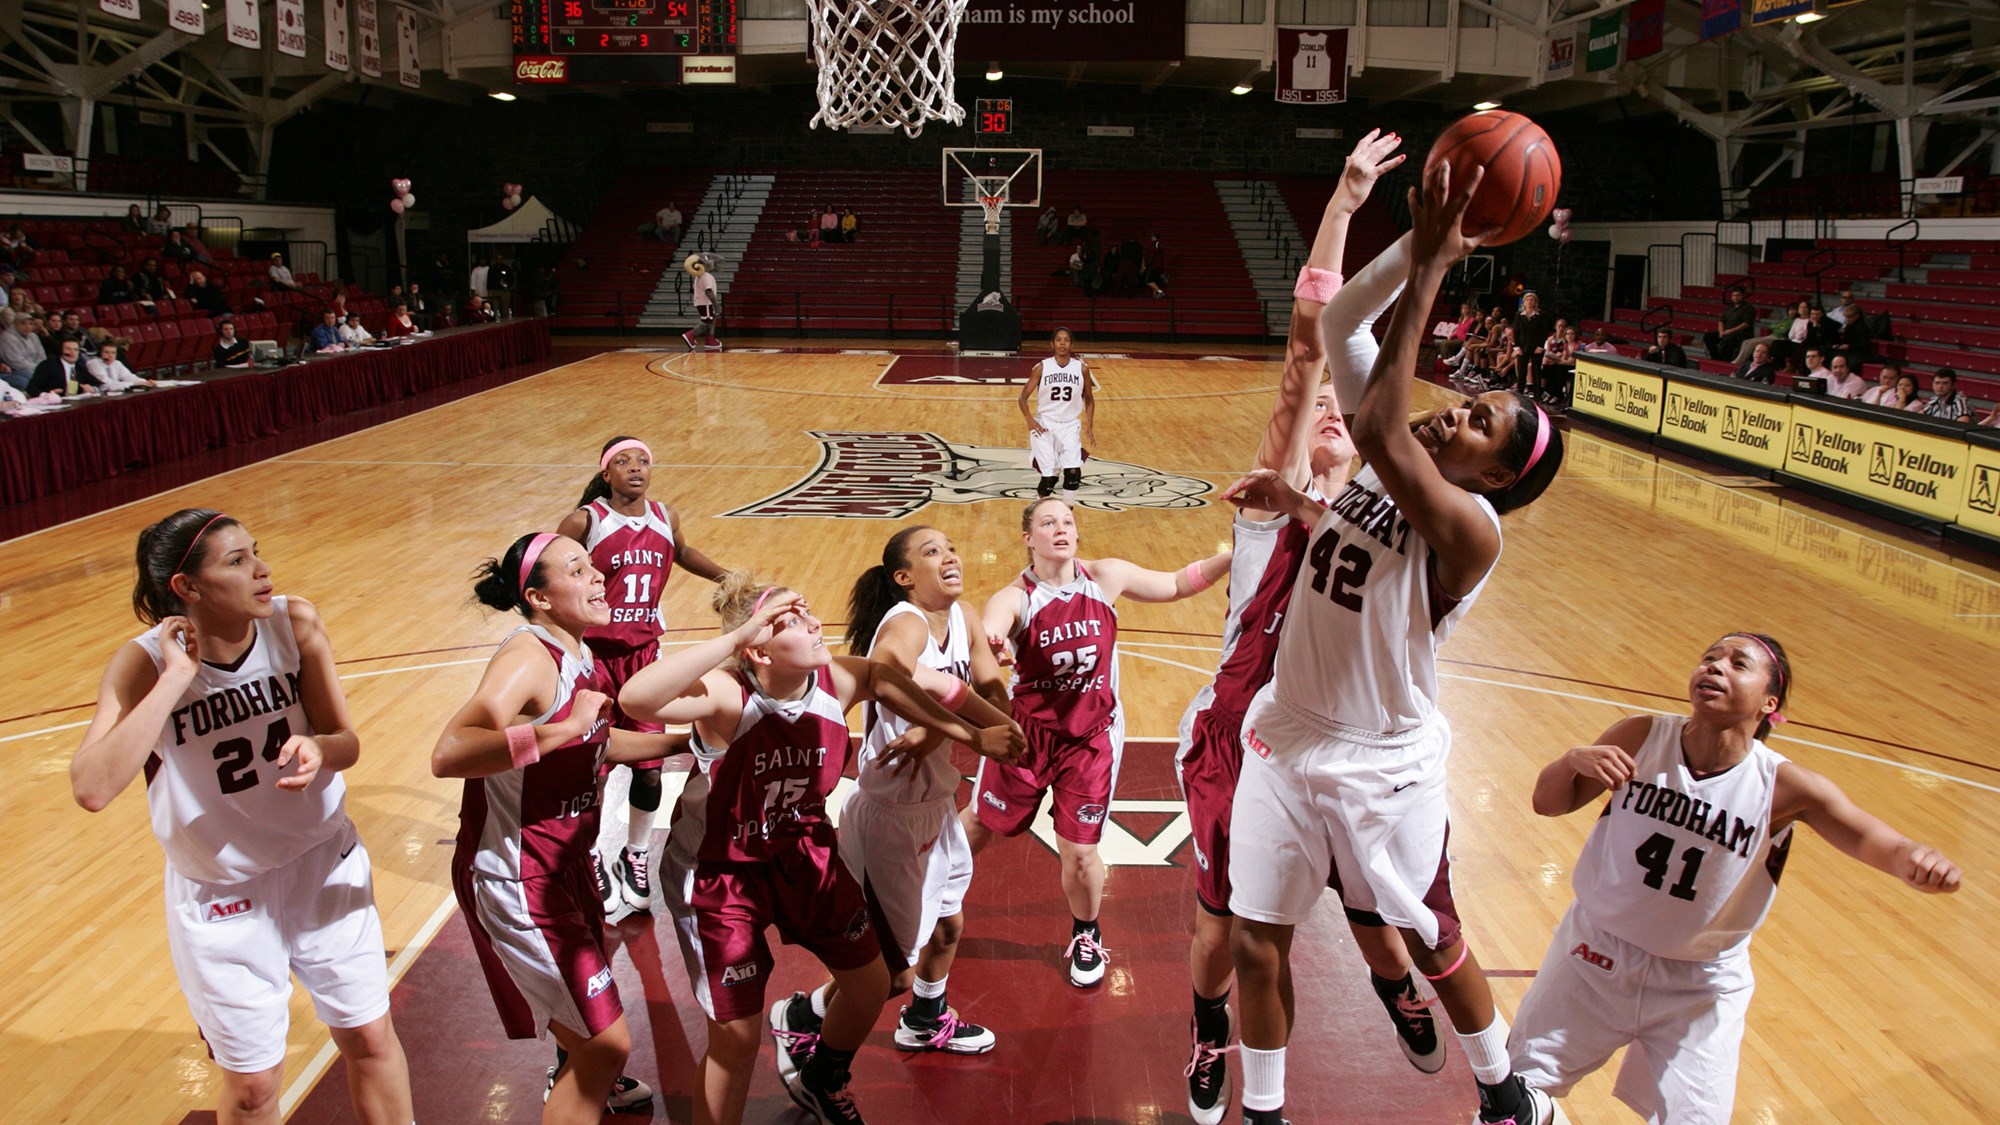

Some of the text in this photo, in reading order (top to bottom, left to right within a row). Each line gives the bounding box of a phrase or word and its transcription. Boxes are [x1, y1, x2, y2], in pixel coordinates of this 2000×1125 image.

[563, 1, 583, 17] 36
[667, 1, 687, 17] 54
[1009, 3, 1026, 24] is
[1031, 9, 1064, 30] my
[1068, 2, 1135, 24] school
[629, 14, 638, 26] 2
[567, 35, 575, 46] 4
[600, 33, 609, 47] 2
[640, 33, 649, 47] 3
[680, 35, 689, 47] 2
[516, 60, 566, 79] Coca-Cola
[1306, 55, 1316, 68] 11
[1281, 89, 1302, 102] 1951
[1316, 90, 1340, 102] 1955
[982, 113, 1006, 132] 30
[55, 158, 69, 171] 105
[1044, 373, 1080, 386] FORDHAM
[1588, 375, 1614, 392] Yellow
[1051, 386, 1072, 401] 23
[1586, 390, 1605, 406] Book
[1629, 384, 1659, 405] Yellow
[1627, 400, 1649, 420] Book
[1683, 397, 1720, 418] Yellow
[1680, 415, 1707, 434] Book
[1742, 409, 1785, 433] Yellow
[1738, 429, 1770, 451] Book
[1814, 428, 1866, 456] Yellow
[1811, 450, 1850, 475] Book
[1897, 448, 1959, 480] Yellow
[1892, 471, 1939, 500] Book
[1331, 479, 1411, 556] ORDHAM
[611, 549, 663, 570] SAINT
[1310, 527, 1373, 613] 42
[623, 573, 652, 603] 11
[1039, 619, 1102, 649] SAINT
[1051, 645, 1098, 677] 25
[213, 716, 293, 794] 24
[754, 746, 827, 777] SAINT
[763, 776, 810, 812] 15
[1079, 814, 1103, 825] SJU
[1622, 780, 1756, 858] FORDHAM
[1635, 832, 1705, 902] 41
[207, 899, 251, 921] A10
[1570, 942, 1614, 971] A10
[721, 964, 757, 984] A10
